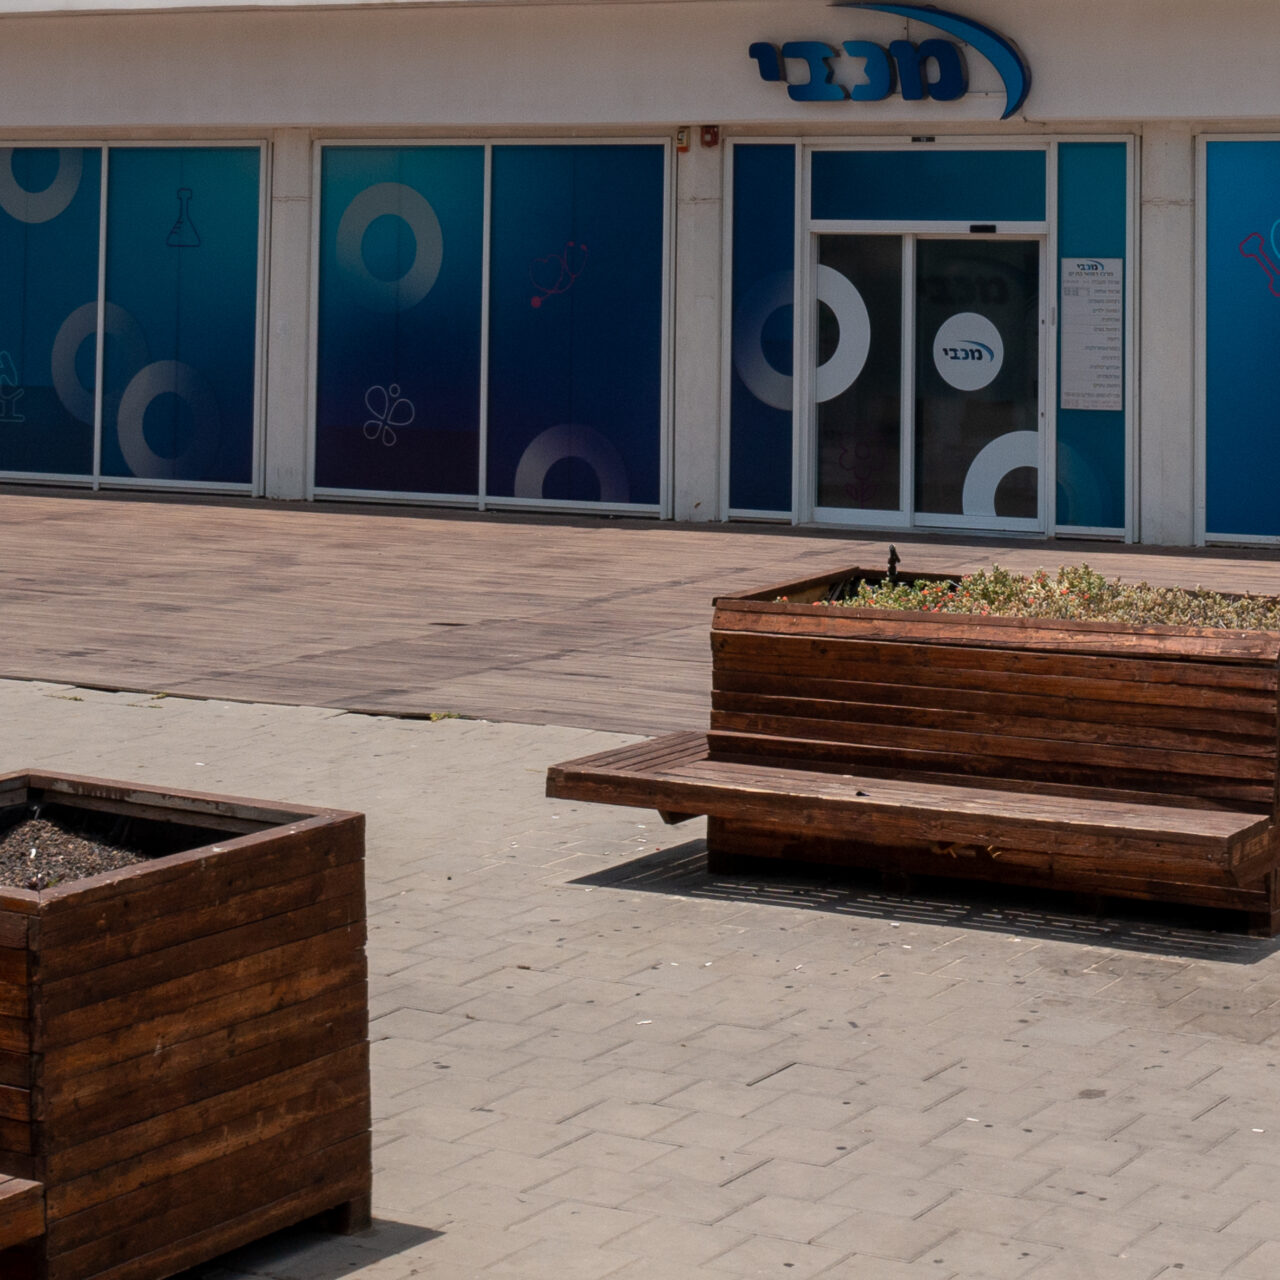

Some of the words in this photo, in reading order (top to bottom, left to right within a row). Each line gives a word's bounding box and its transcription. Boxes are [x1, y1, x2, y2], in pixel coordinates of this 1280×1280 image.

[748, 38, 968, 102] מכבי
[1076, 263, 1099, 271] מכבי
[942, 347, 983, 361] מכבי
